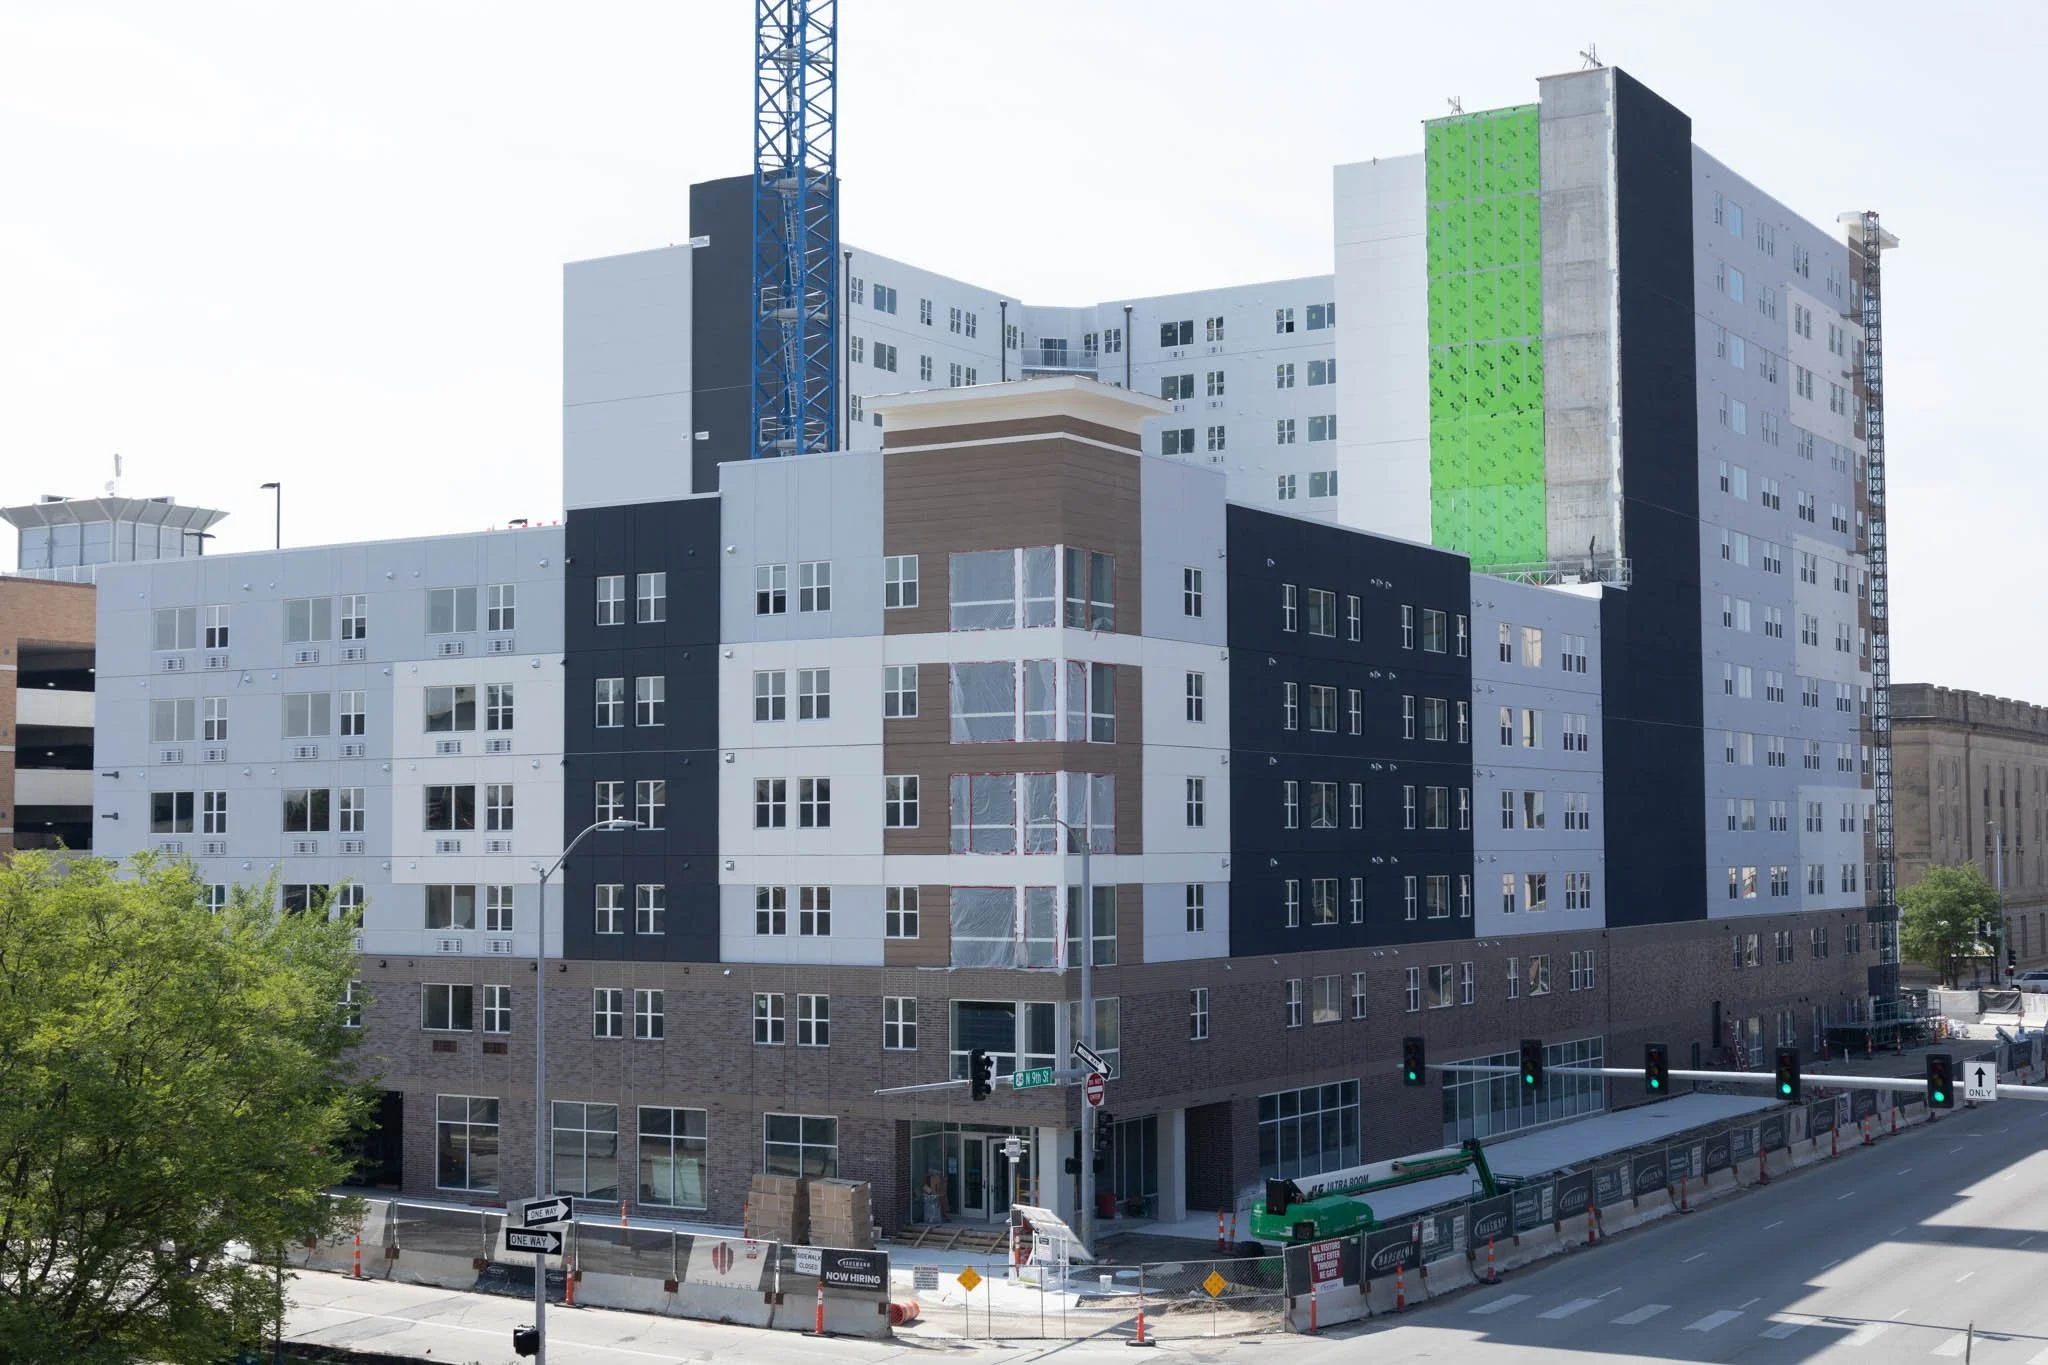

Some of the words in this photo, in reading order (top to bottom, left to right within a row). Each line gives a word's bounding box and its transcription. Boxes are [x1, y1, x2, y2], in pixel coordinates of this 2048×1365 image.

[1025, 1072, 1031, 1085] N
[1031, 1071, 1041, 1084] 9th
[1042, 1070, 1049, 1083] St
[1969, 1089, 1992, 1097] ONLY
[1327, 1178, 1348, 1192] ULTRA
[1349, 1174, 1369, 1187] BOOM
[531, 1209, 544, 1219] ONE
[545, 1207, 558, 1216] WAY
[511, 1235, 528, 1245] ONE
[529, 1237, 547, 1247] WAY
[1311, 1244, 1320, 1254] ALL
[1320, 1240, 1341, 1253] VISITORS
[797, 1252, 821, 1261] SIDEWALK
[1313, 1252, 1327, 1263] MUST
[1326, 1249, 1340, 1260] ENTER
[799, 1262, 818, 1271] CLOSED
[826, 1271, 849, 1282] NOW
[850, 1273, 881, 1285] HIRING
